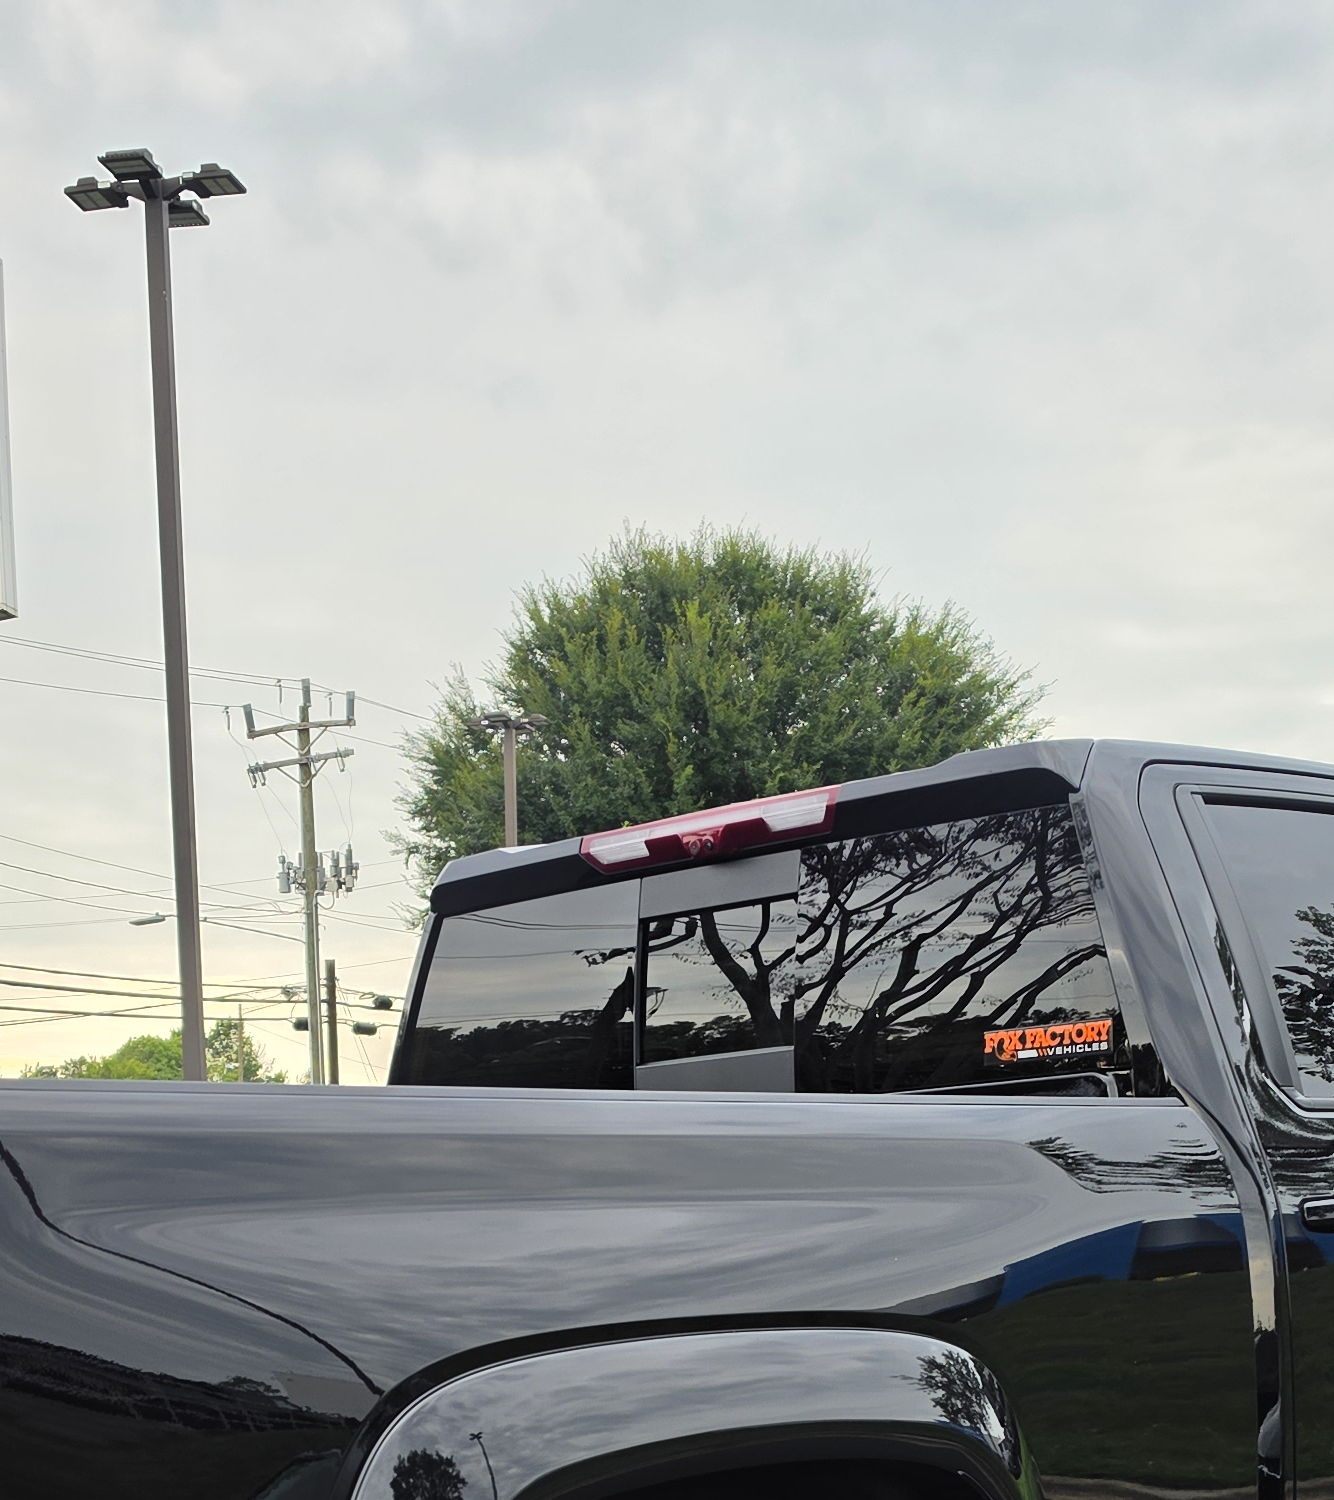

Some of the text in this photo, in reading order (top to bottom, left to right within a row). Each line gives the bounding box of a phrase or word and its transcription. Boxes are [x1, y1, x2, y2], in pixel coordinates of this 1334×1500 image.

[984, 1019, 1112, 1062] FOX FACTORY
[1047, 1041, 1109, 1056] VEHICLES
